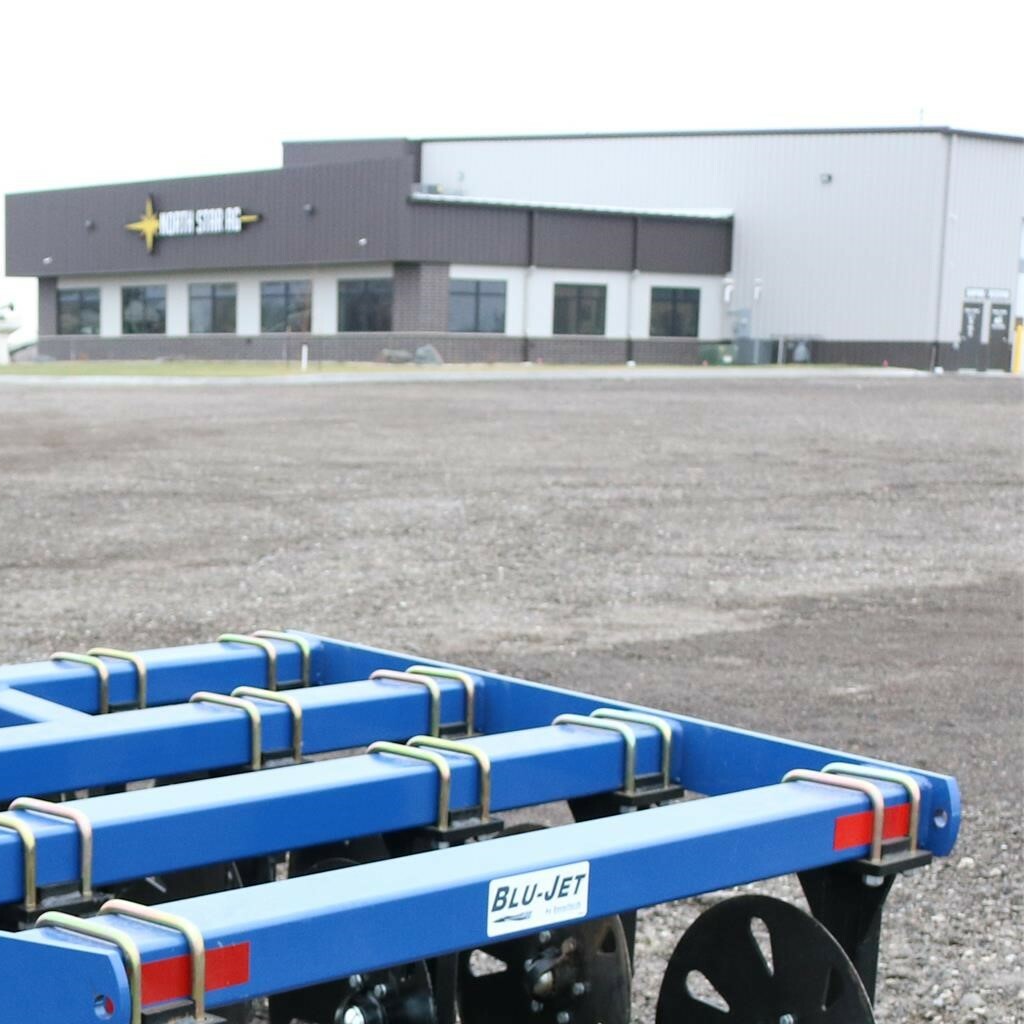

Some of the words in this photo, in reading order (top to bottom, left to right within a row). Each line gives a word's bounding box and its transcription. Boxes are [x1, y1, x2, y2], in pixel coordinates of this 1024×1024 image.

[158, 210, 195, 236] NORTH
[195, 207, 225, 235] STAR
[491, 873, 586, 912] BLU-JET
